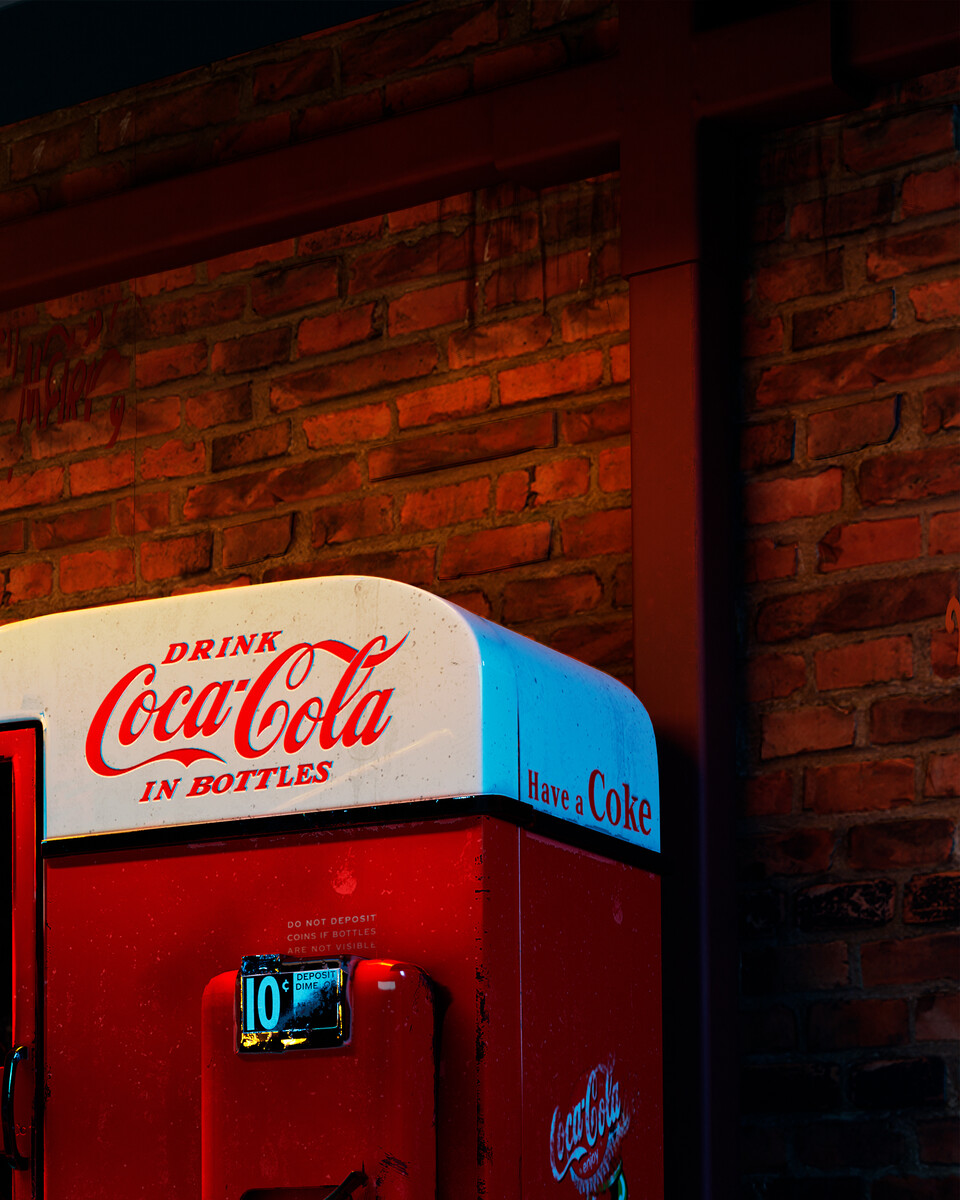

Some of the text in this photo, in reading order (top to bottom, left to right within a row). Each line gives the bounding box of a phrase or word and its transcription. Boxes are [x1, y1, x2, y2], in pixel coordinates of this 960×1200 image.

[161, 630, 283, 665] DRINK
[85, 630, 410, 777] Coca-Cola
[139, 760, 333, 803] IN BOTTLES
[527, 769, 653, 837] Have a Coke
[287, 914, 377, 929] DO NOT DEPOSIT
[287, 928, 377, 942] COINS IF BOTTLES
[287, 941, 377, 954] ARE NOT VISIBLE
[296, 970, 336, 981] DEPOSIT
[295, 981, 319, 991] DIME
